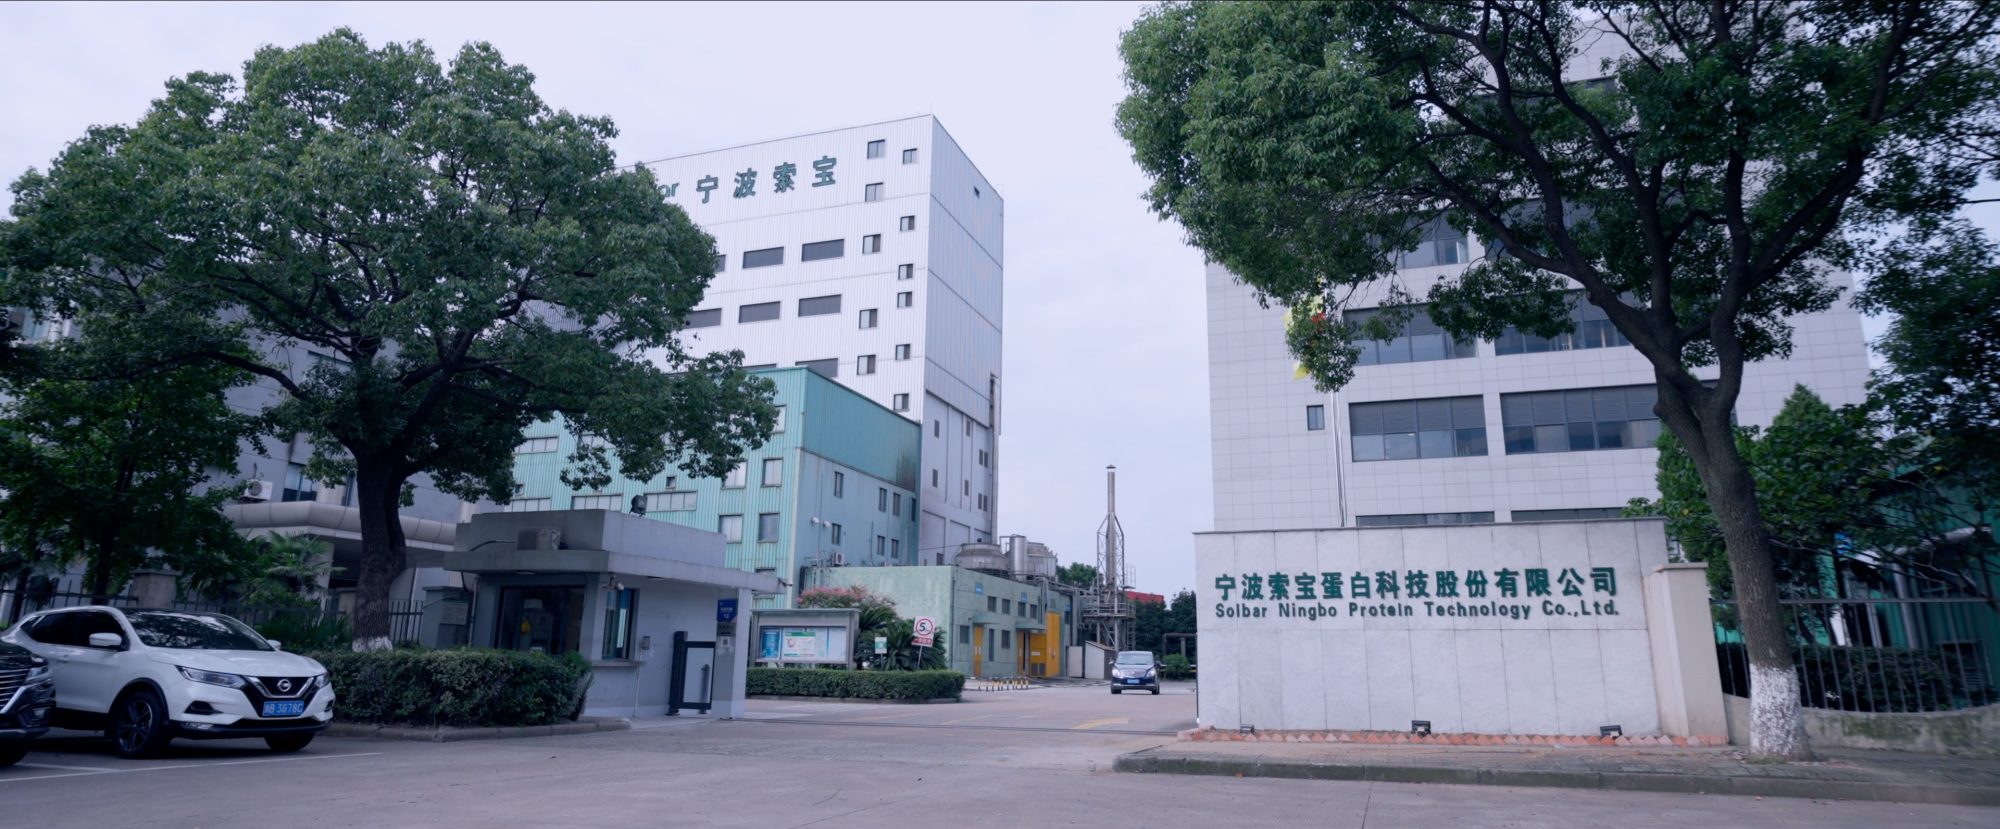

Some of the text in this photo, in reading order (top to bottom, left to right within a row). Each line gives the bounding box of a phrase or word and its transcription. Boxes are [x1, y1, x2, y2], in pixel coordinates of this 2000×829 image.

[696, 155, 837, 204] 宁波索宝
[1215, 567, 1617, 601] 宁波索宝蛋白科技股份有限公司
[1215, 600, 1619, 621] Solbar Ningbo Protein Technology Co.,Ltd.
